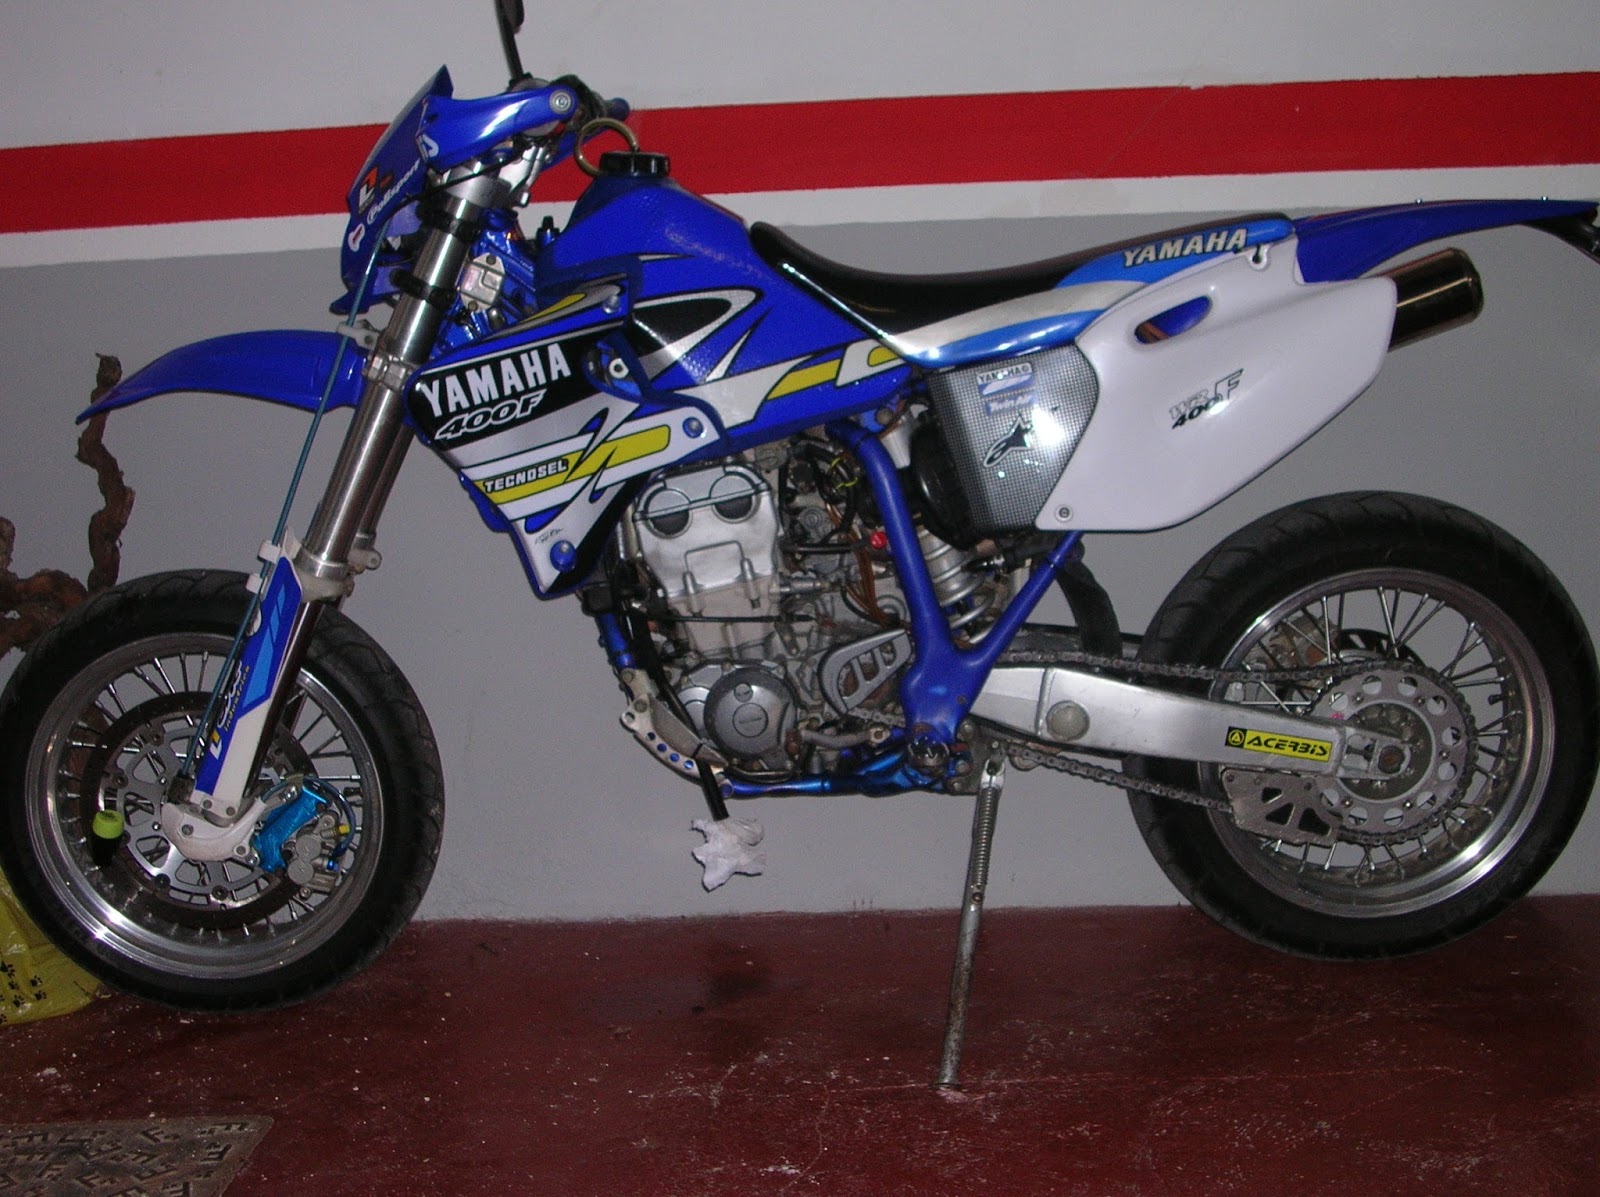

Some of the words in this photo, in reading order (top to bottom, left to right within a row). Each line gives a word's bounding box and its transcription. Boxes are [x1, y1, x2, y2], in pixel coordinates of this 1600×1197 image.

[1124, 228, 1248, 267] YAMAHA
[420, 343, 572, 418] YAMAHA
[434, 388, 548, 440] 400F
[484, 459, 569, 493] TECNOSEL
[1247, 735, 1329, 757] ACERBIS
